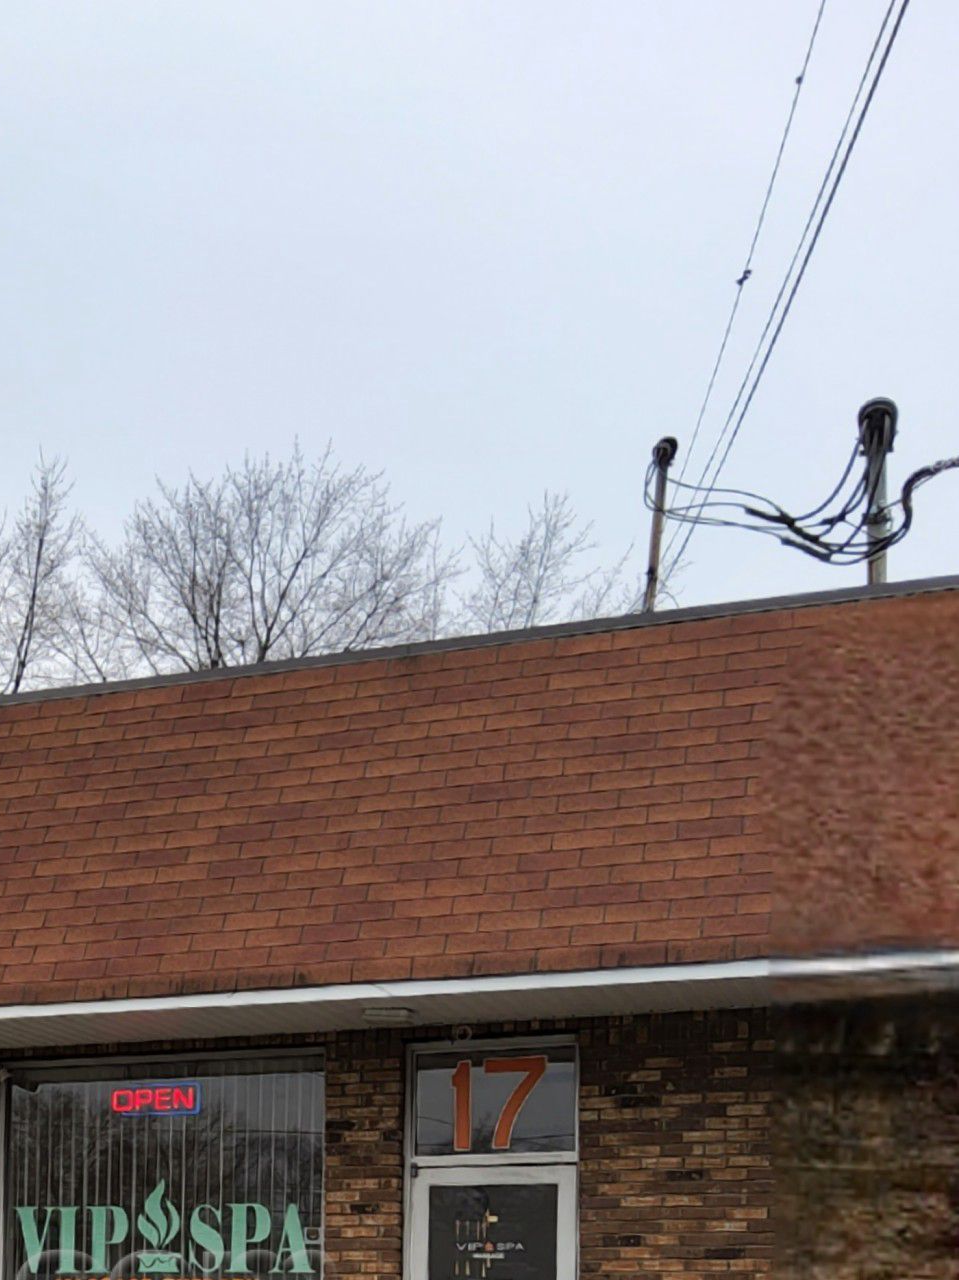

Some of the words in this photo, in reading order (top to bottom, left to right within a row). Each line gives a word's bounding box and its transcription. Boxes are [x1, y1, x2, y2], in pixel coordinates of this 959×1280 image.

[111, 1087, 194, 1112] OPEN
[451, 1054, 548, 1151] 17
[14, 1205, 129, 1275] VIP
[189, 1203, 316, 1274] SPA
[496, 1242, 524, 1251] SPA
